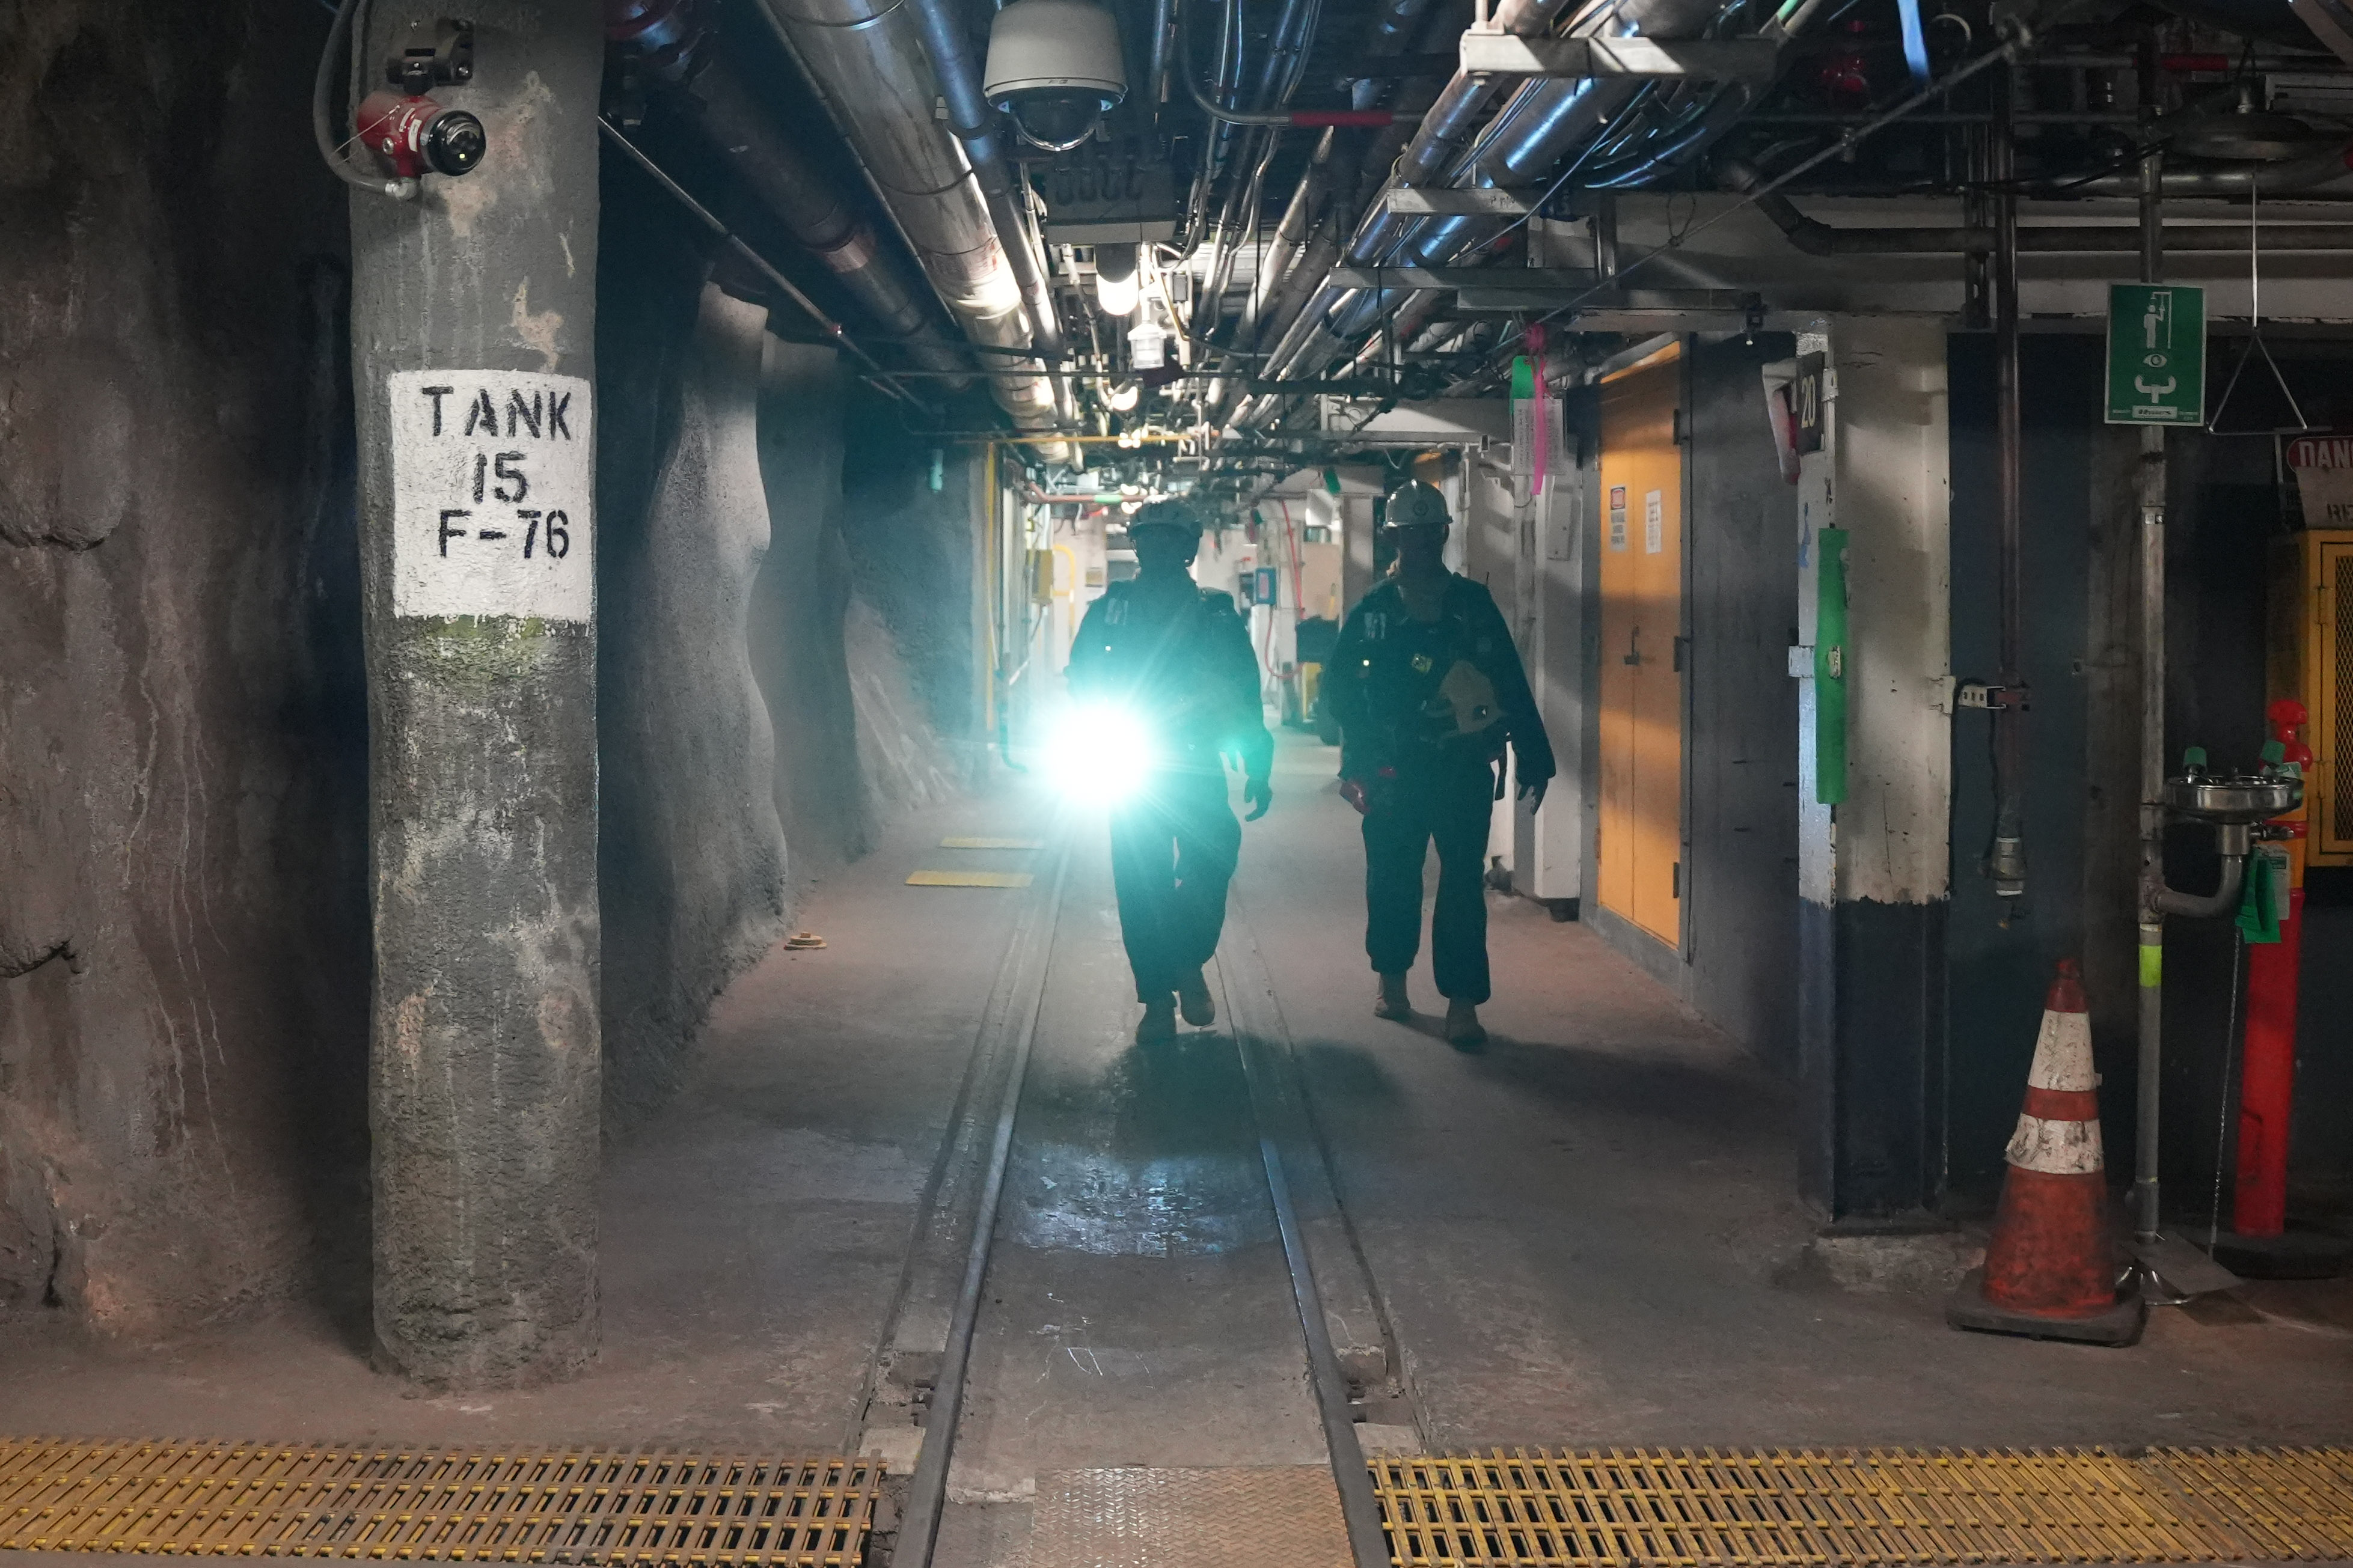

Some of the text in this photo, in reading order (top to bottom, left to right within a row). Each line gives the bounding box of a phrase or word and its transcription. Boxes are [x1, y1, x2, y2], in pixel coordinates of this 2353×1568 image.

[422, 386, 572, 441] TANK
[1801, 373, 1816, 429] 20
[473, 451, 530, 504] 15
[2298, 440, 2353, 468] DAN
[439, 510, 569, 560] F-76
